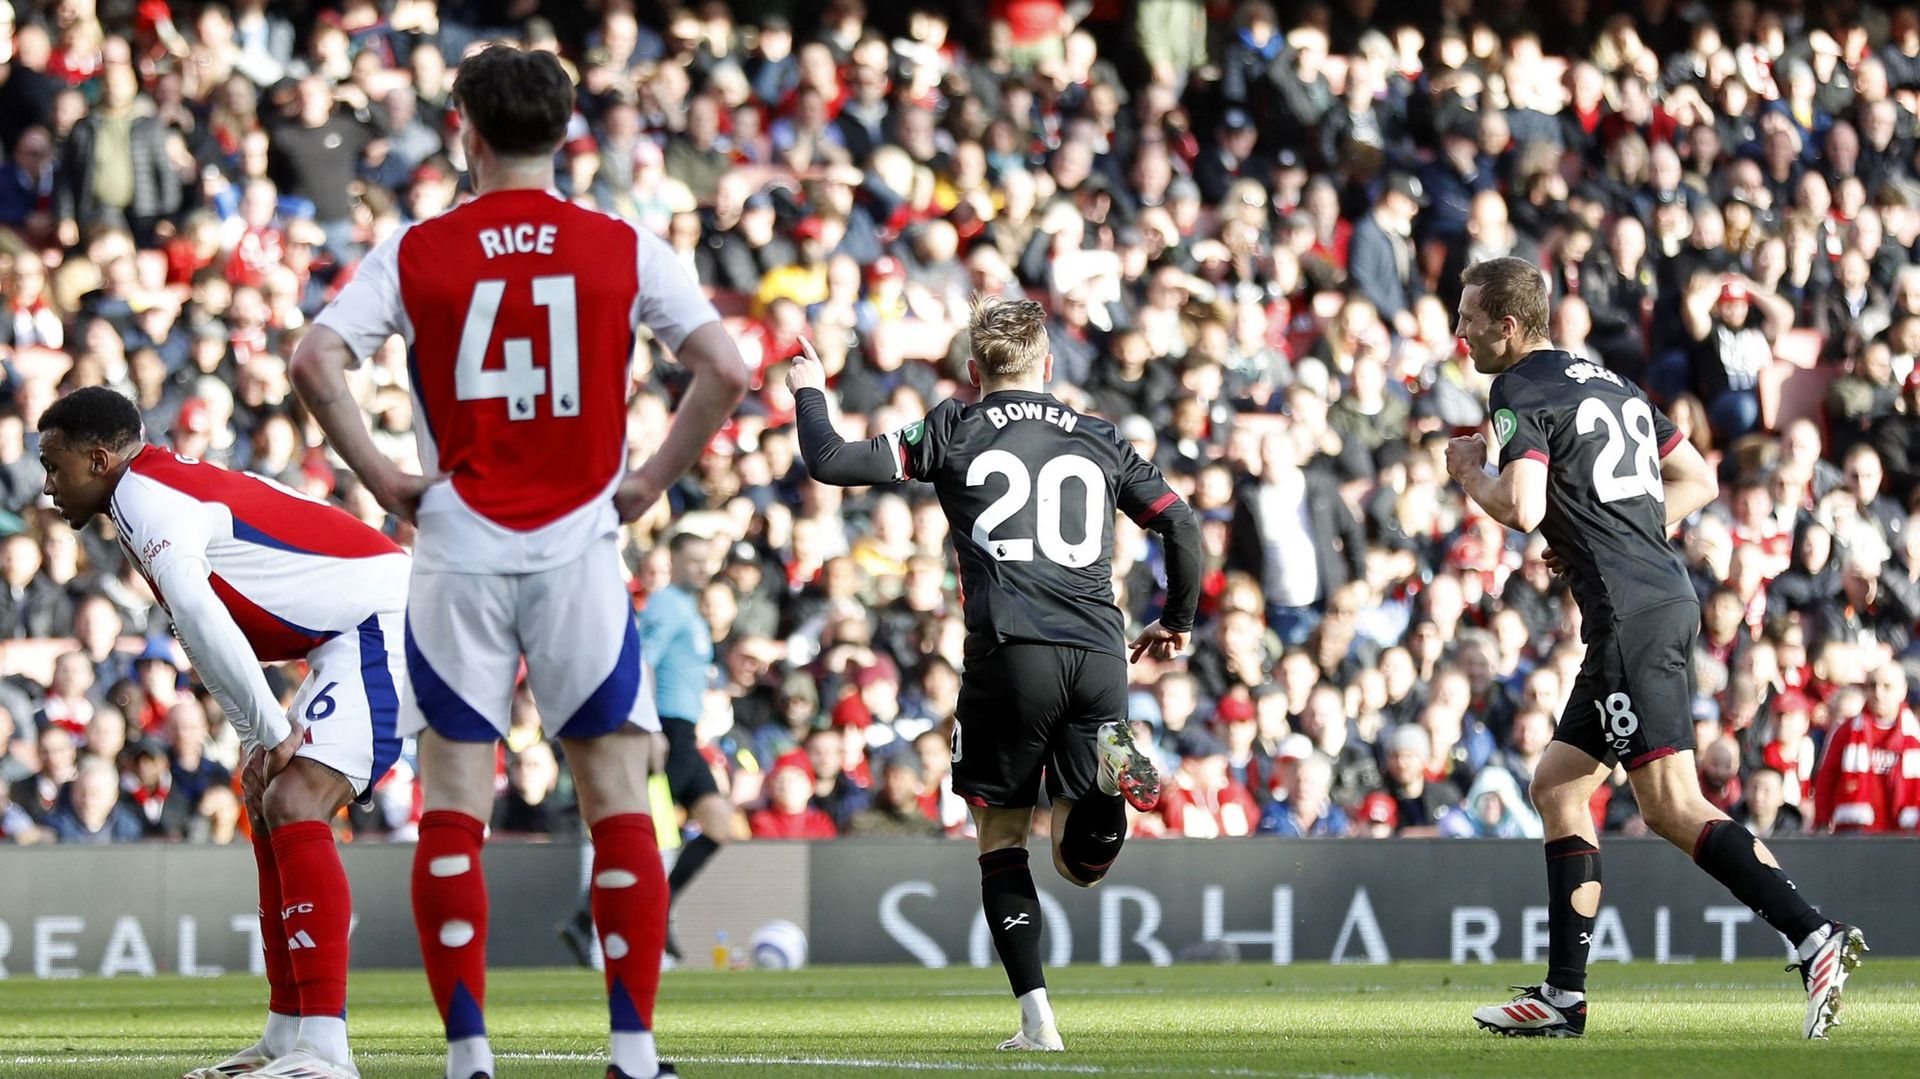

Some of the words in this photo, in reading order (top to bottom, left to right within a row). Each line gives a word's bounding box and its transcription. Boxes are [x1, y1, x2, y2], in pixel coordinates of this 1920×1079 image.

[479, 223, 558, 260] RICE
[455, 273, 580, 421] 41
[986, 401, 1078, 434] BOWEN
[1576, 397, 1665, 504] 28
[965, 449, 1105, 569] 20
[305, 681, 339, 722] 6
[0, 914, 360, 979] EALT
